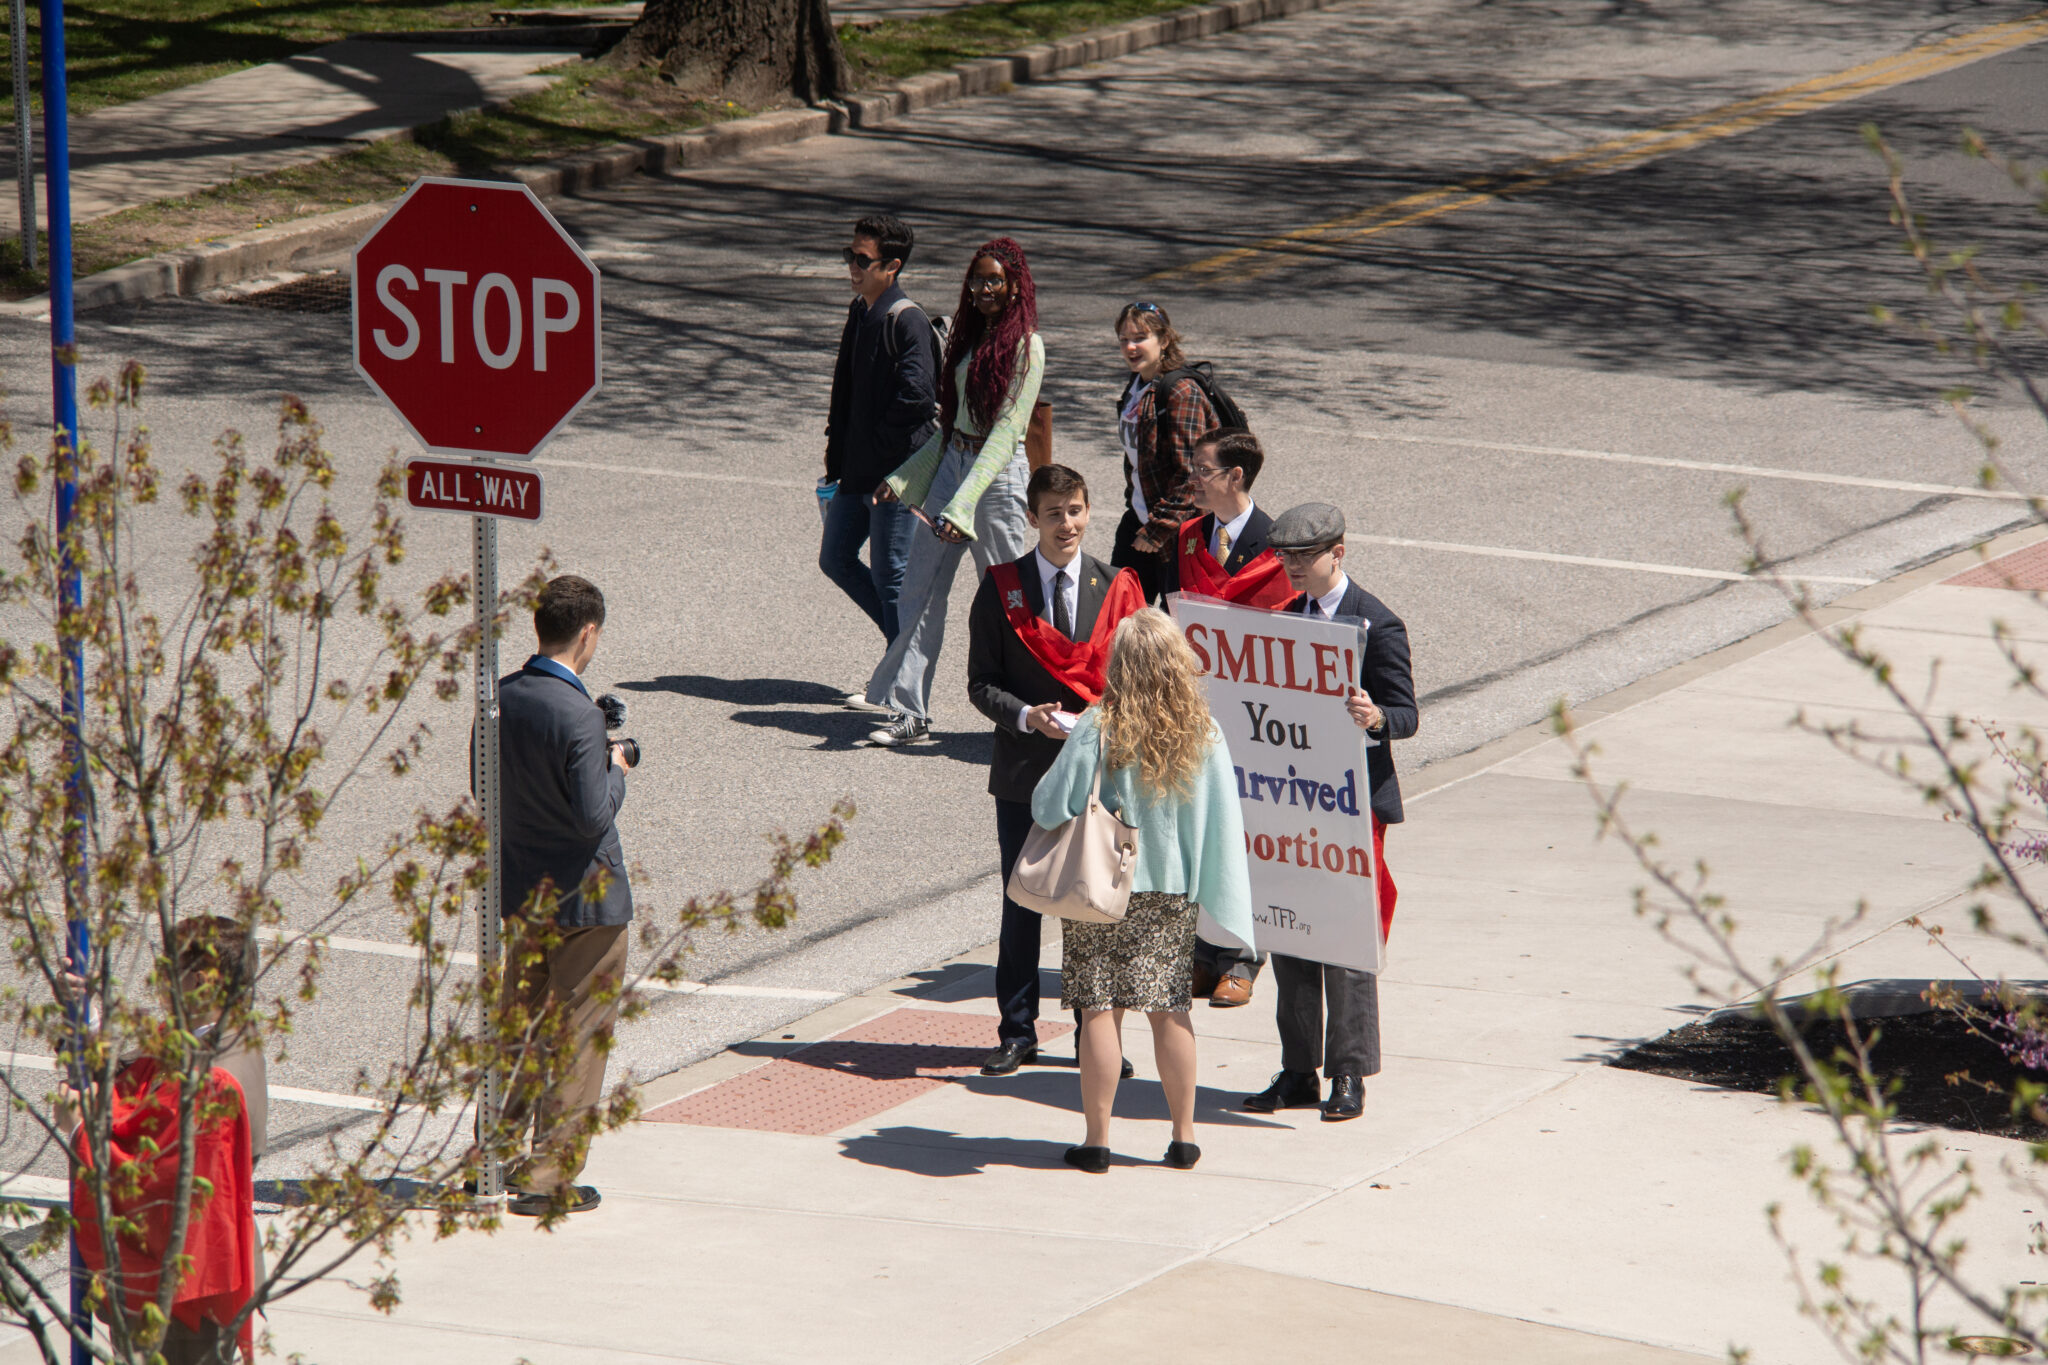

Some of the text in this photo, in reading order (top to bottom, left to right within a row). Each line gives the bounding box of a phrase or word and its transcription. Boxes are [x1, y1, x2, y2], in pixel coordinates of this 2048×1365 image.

[372, 264, 580, 372] STOP
[420, 470, 530, 509] ALL WAY
[1184, 623, 1356, 697] SMILE!
[1241, 701, 1311, 750] You
[1233, 764, 1360, 816] rvived
[1244, 827, 1371, 878] ortion
